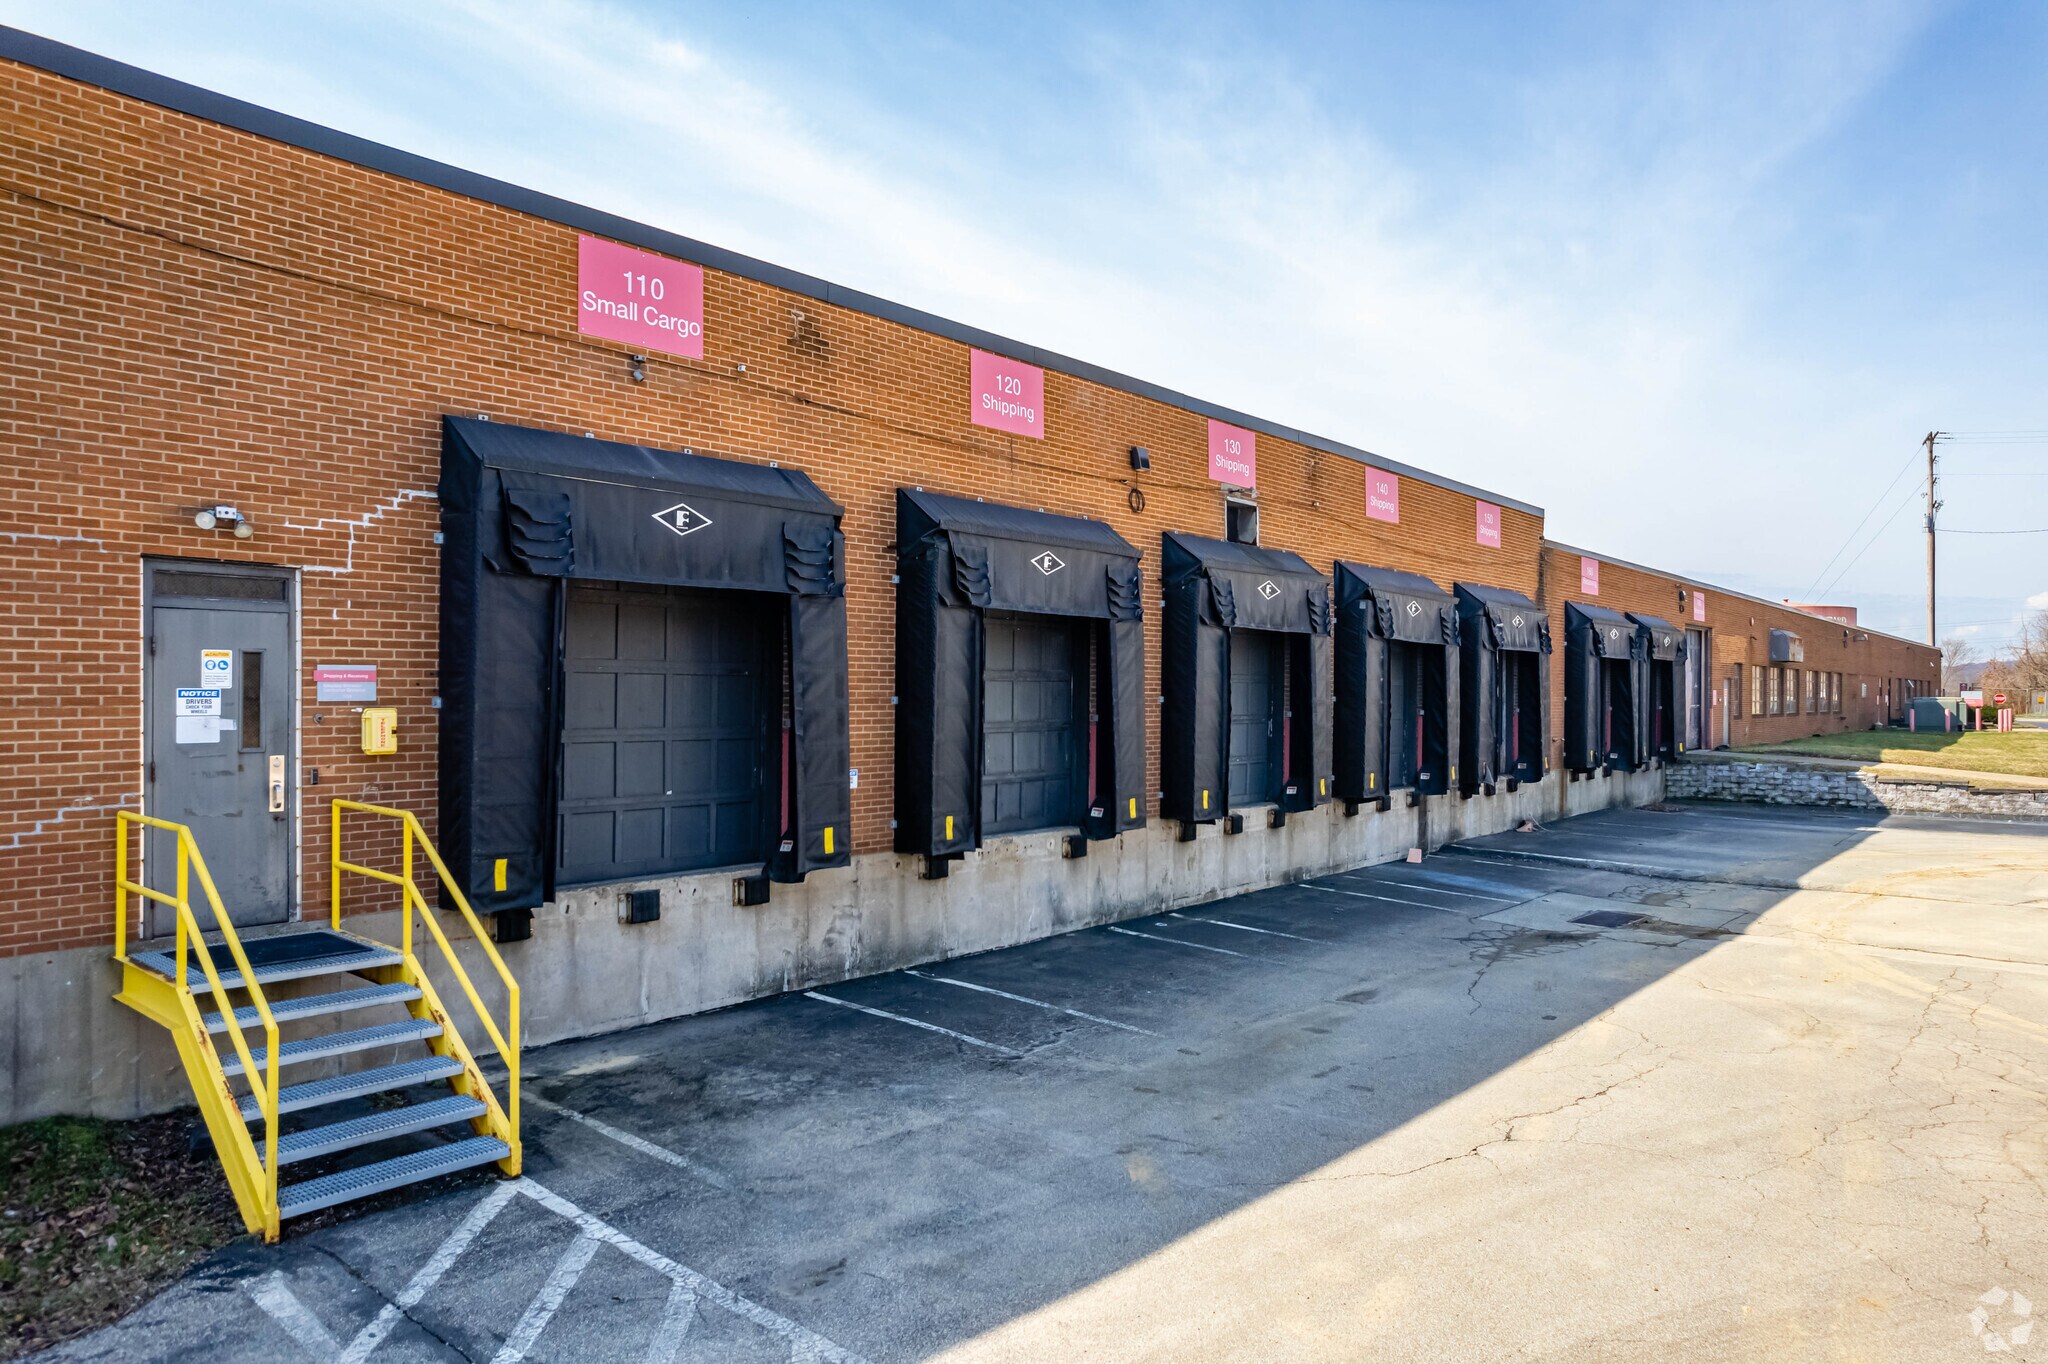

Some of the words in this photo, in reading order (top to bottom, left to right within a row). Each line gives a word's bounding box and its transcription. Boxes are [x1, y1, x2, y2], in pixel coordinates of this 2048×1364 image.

[623, 271, 664, 300] 110
[582, 290, 638, 321] Small
[643, 306, 700, 338] Cargo
[996, 374, 1021, 396] 120
[982, 393, 1034, 423] Shipping
[1224, 438, 1241, 455] 130
[1215, 454, 1249, 477] Shipping
[1376, 482, 1389, 495] 140
[1370, 495, 1395, 513] Shipping
[1480, 525, 1498, 540] Shipping
